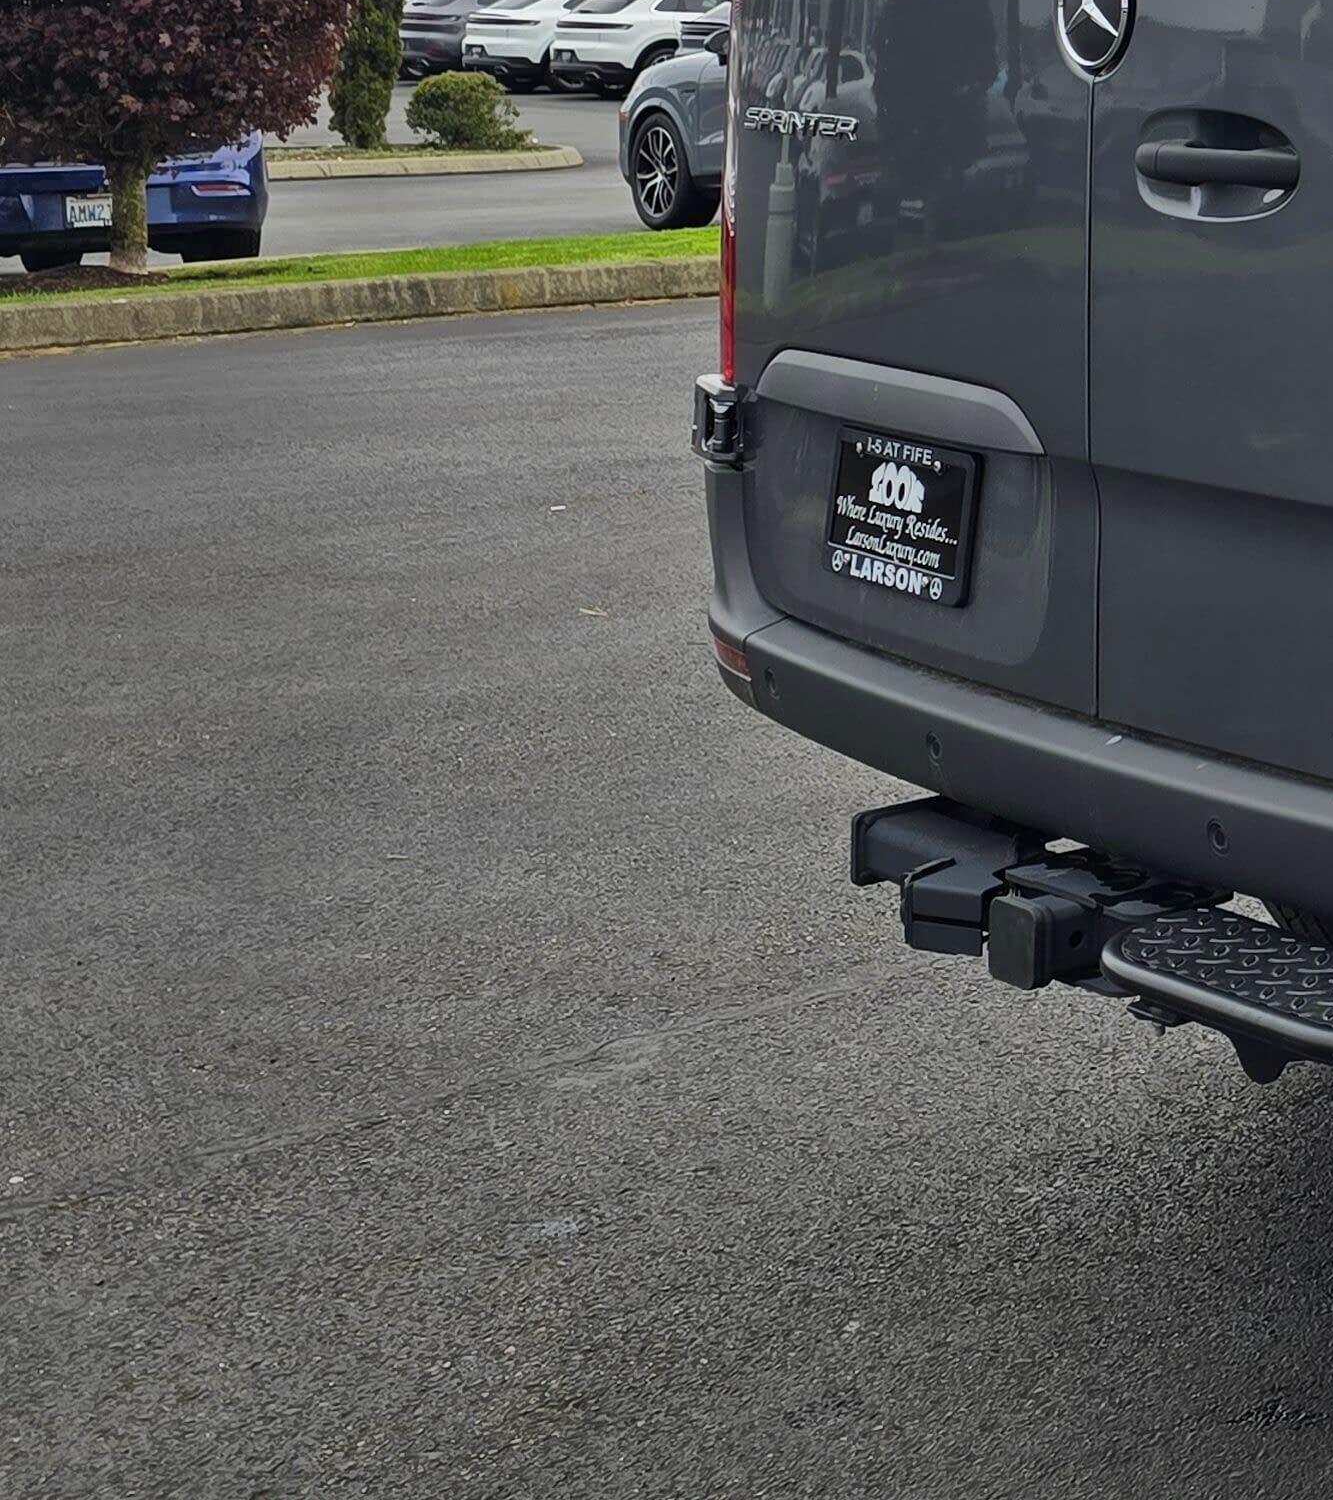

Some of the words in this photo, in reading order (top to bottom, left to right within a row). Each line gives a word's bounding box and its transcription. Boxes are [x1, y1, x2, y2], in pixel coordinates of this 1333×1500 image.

[744, 107, 858, 140] SPRINTER
[883, 441, 901, 458] AT
[903, 444, 933, 466] FIFE
[837, 495, 867, 521] Where
[867, 505, 905, 539] Luxury
[845, 525, 941, 569] LarsonLuxury.com
[850, 554, 923, 595] LARSON
